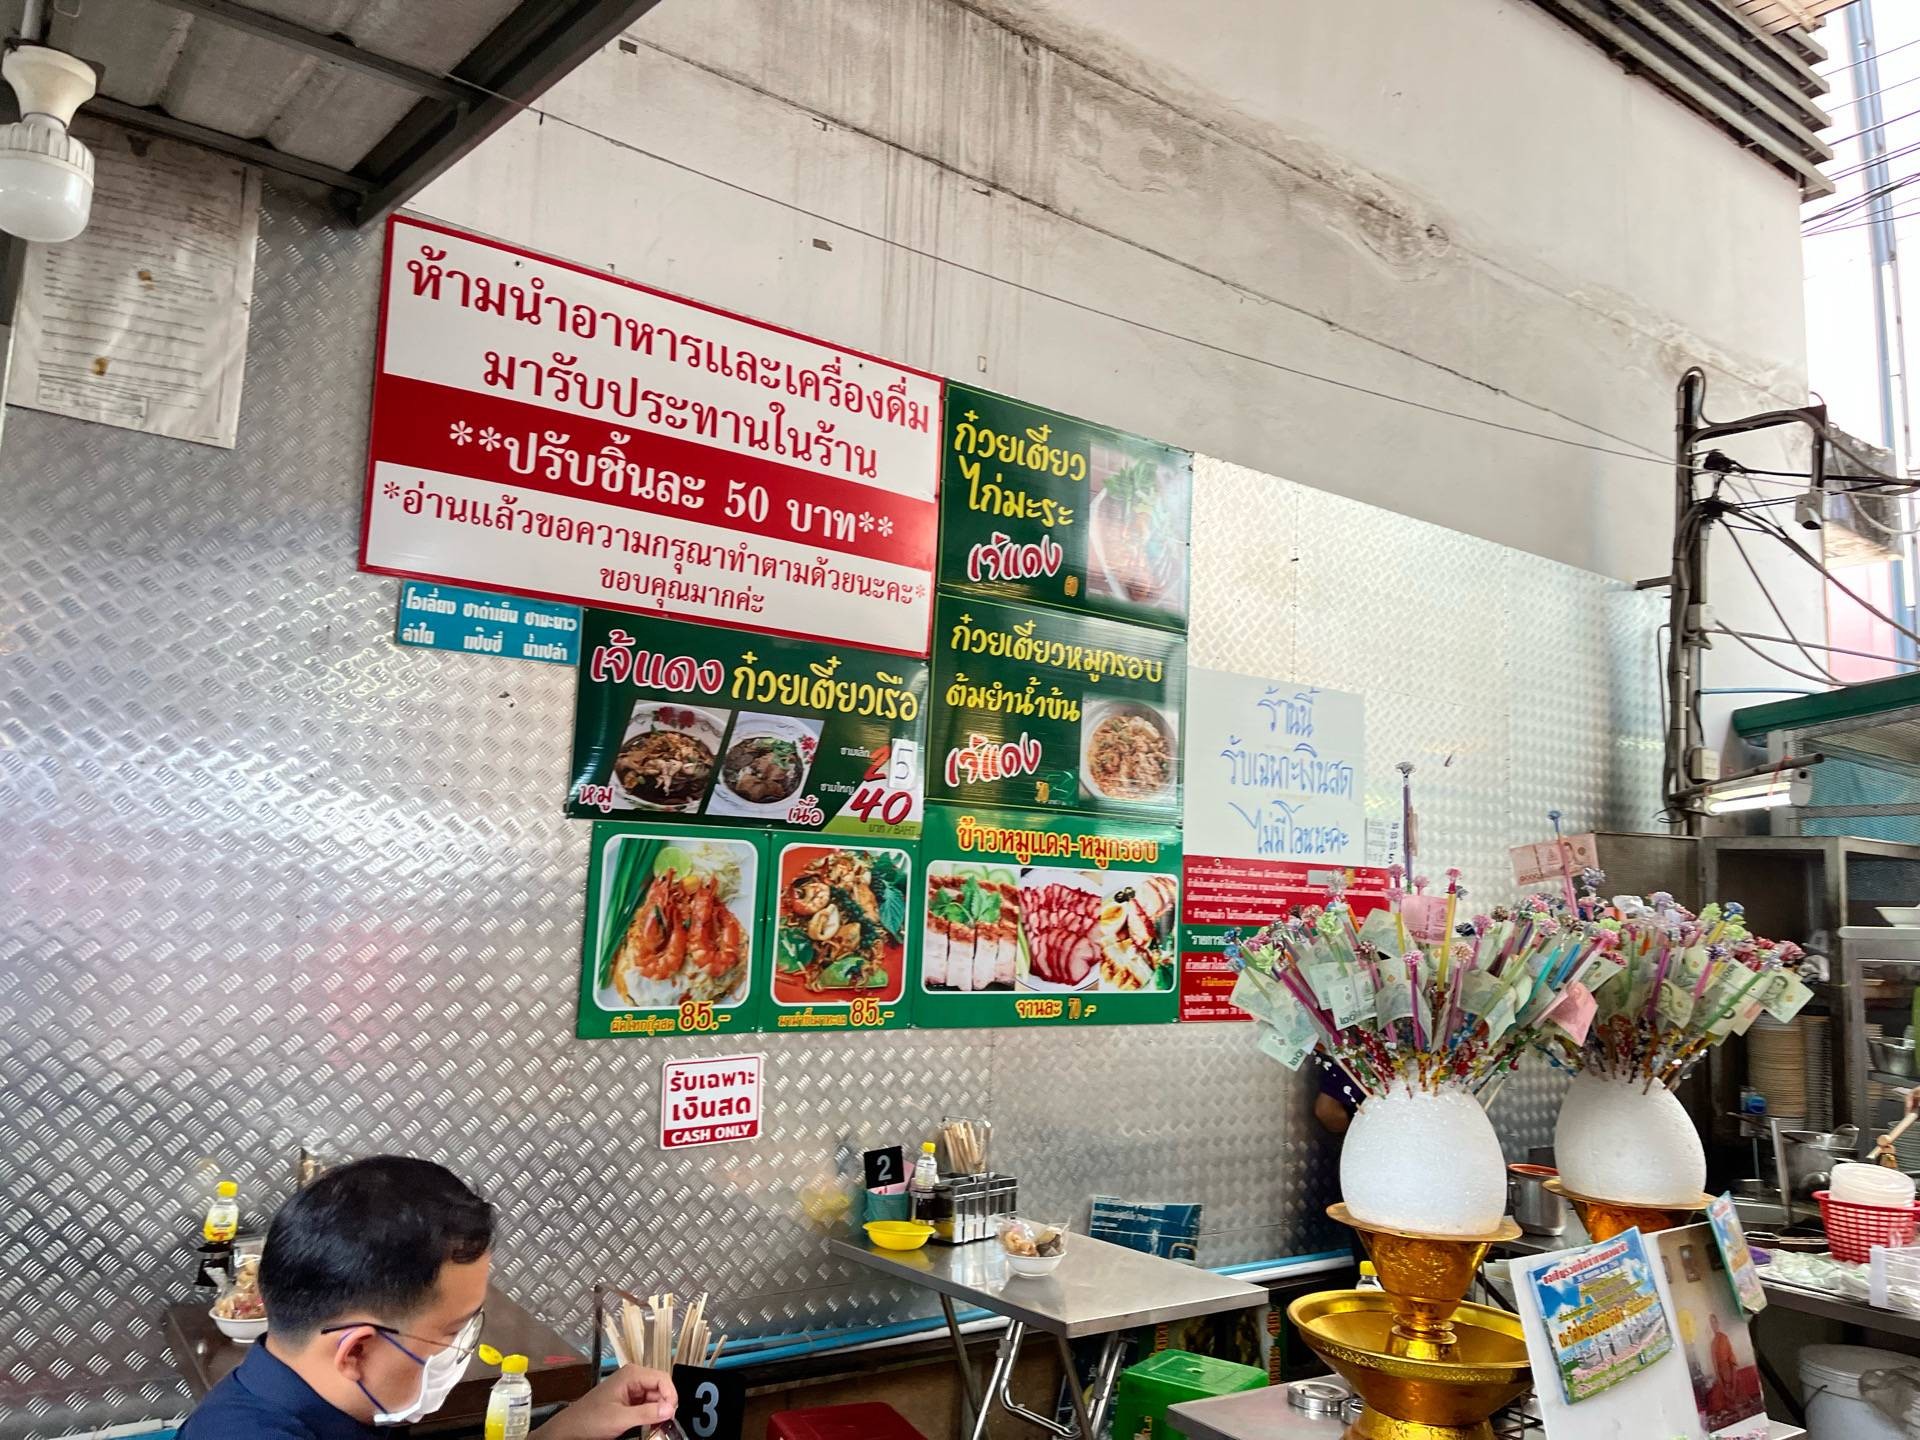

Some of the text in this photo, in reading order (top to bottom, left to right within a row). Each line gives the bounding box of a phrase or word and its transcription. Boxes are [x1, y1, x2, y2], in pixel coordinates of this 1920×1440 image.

[406, 245, 929, 434] ห้ามนำอาหารและเครื่องดื่ม
[483, 347, 878, 480] มารับประทานในร้าน
[954, 409, 1087, 481] ก๋วยเตี๋ยว
[724, 480, 770, 523] 50
[958, 455, 1074, 528] ไก่มะระ
[600, 565, 765, 615] ขอบคุณมากค่ะ
[950, 613, 1162, 683] ก๋วยเตี๋ยวหมูกรอบ
[731, 651, 919, 722] ก๋วยเตี๋ยวเรือ
[946, 673, 1081, 722] ต้มยำน้ำข้น
[579, 784, 614, 813] หมู
[786, 794, 824, 825] เนื้อ
[850, 787, 913, 826] 40
[957, 816, 1160, 869] ข้าวหมูแดง-หมูกรอบ
[1015, 999, 1063, 1018] จานละ
[670, 1070, 755, 1092] รับเฉพาะ
[673, 1096, 751, 1121] เงินสด
[671, 1123, 751, 1144] CASH ONLY
[876, 1155, 892, 1181] 2
[692, 1381, 720, 1438] 3
